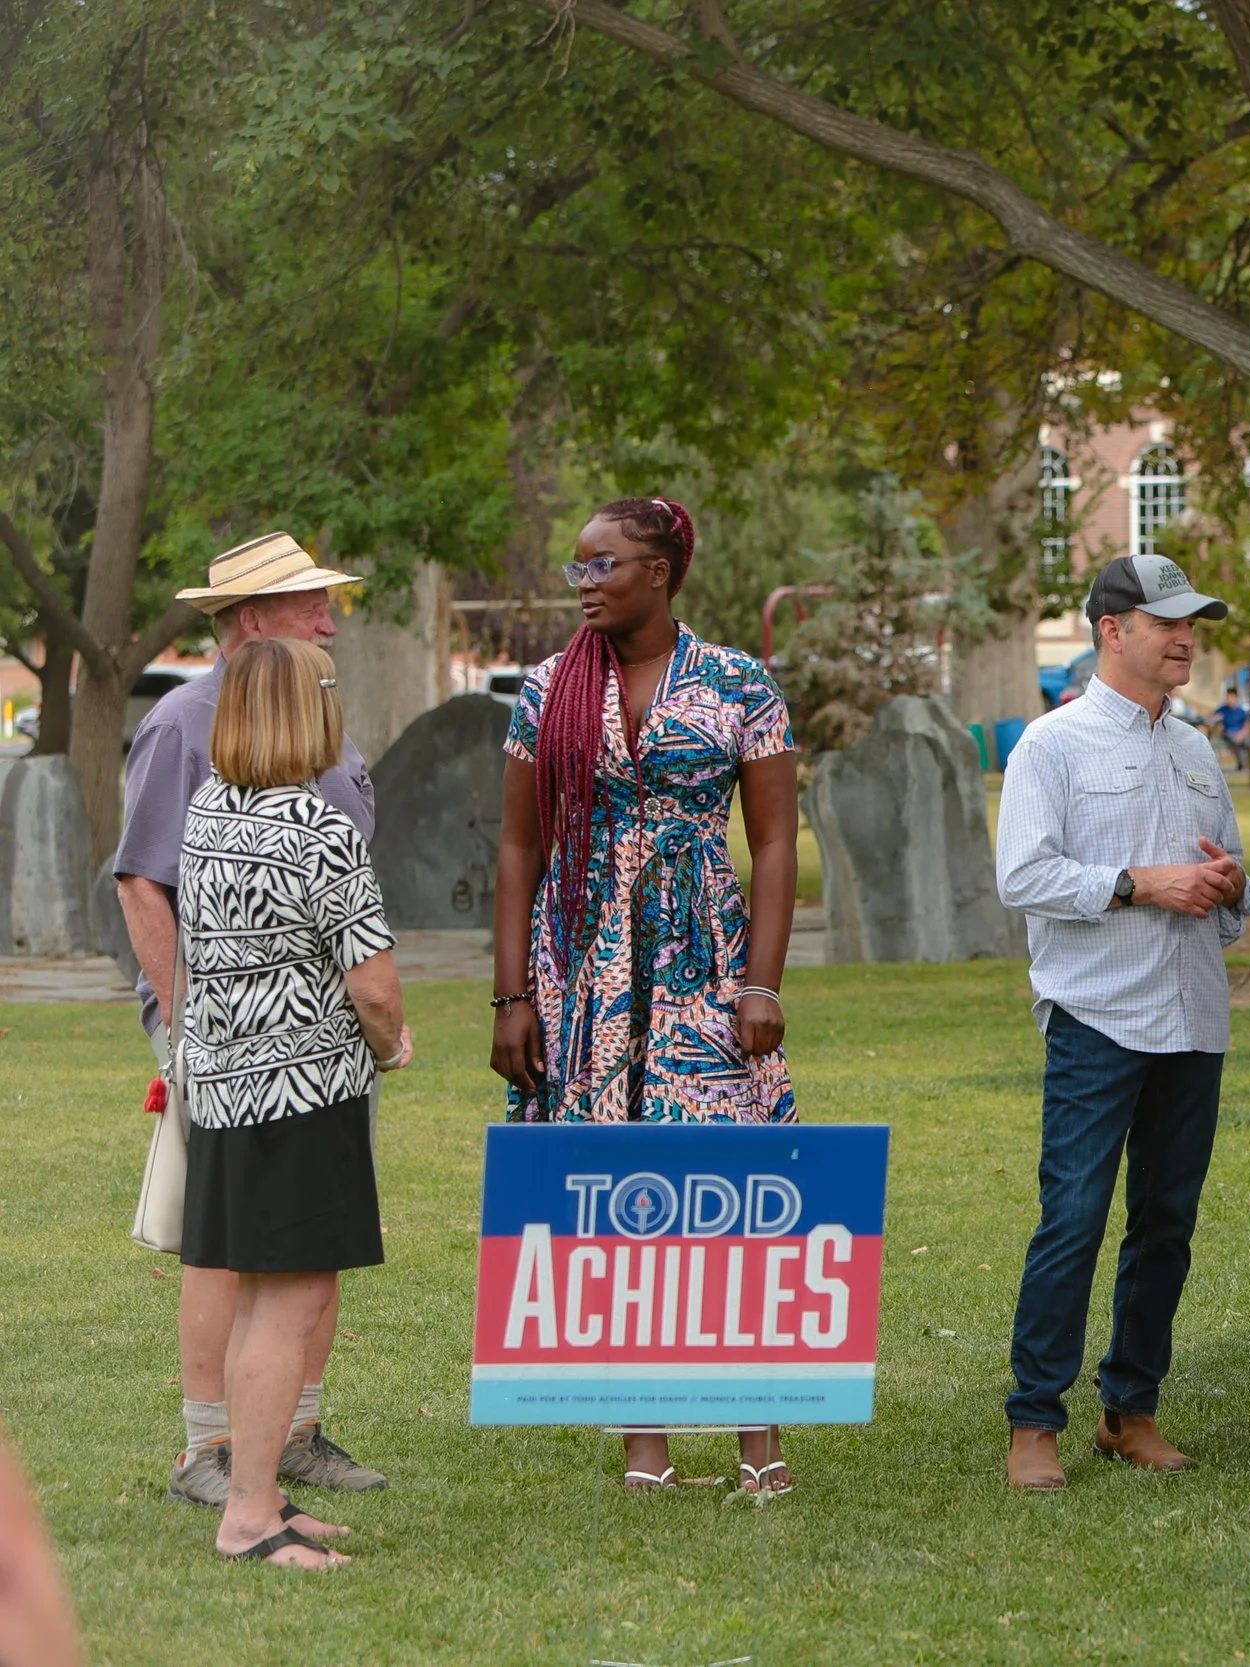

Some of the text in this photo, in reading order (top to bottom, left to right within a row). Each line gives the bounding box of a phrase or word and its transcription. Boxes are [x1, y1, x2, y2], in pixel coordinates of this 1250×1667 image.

[565, 1171, 802, 1240] TODD
[503, 1223, 853, 1349] ACHILLES
[540, 1395, 556, 1404] FOR
[571, 1395, 596, 1404] TODD
[599, 1395, 637, 1404] ACHILLES
[639, 1395, 656, 1404] FOR
[659, 1395, 688, 1404] IDAHO
